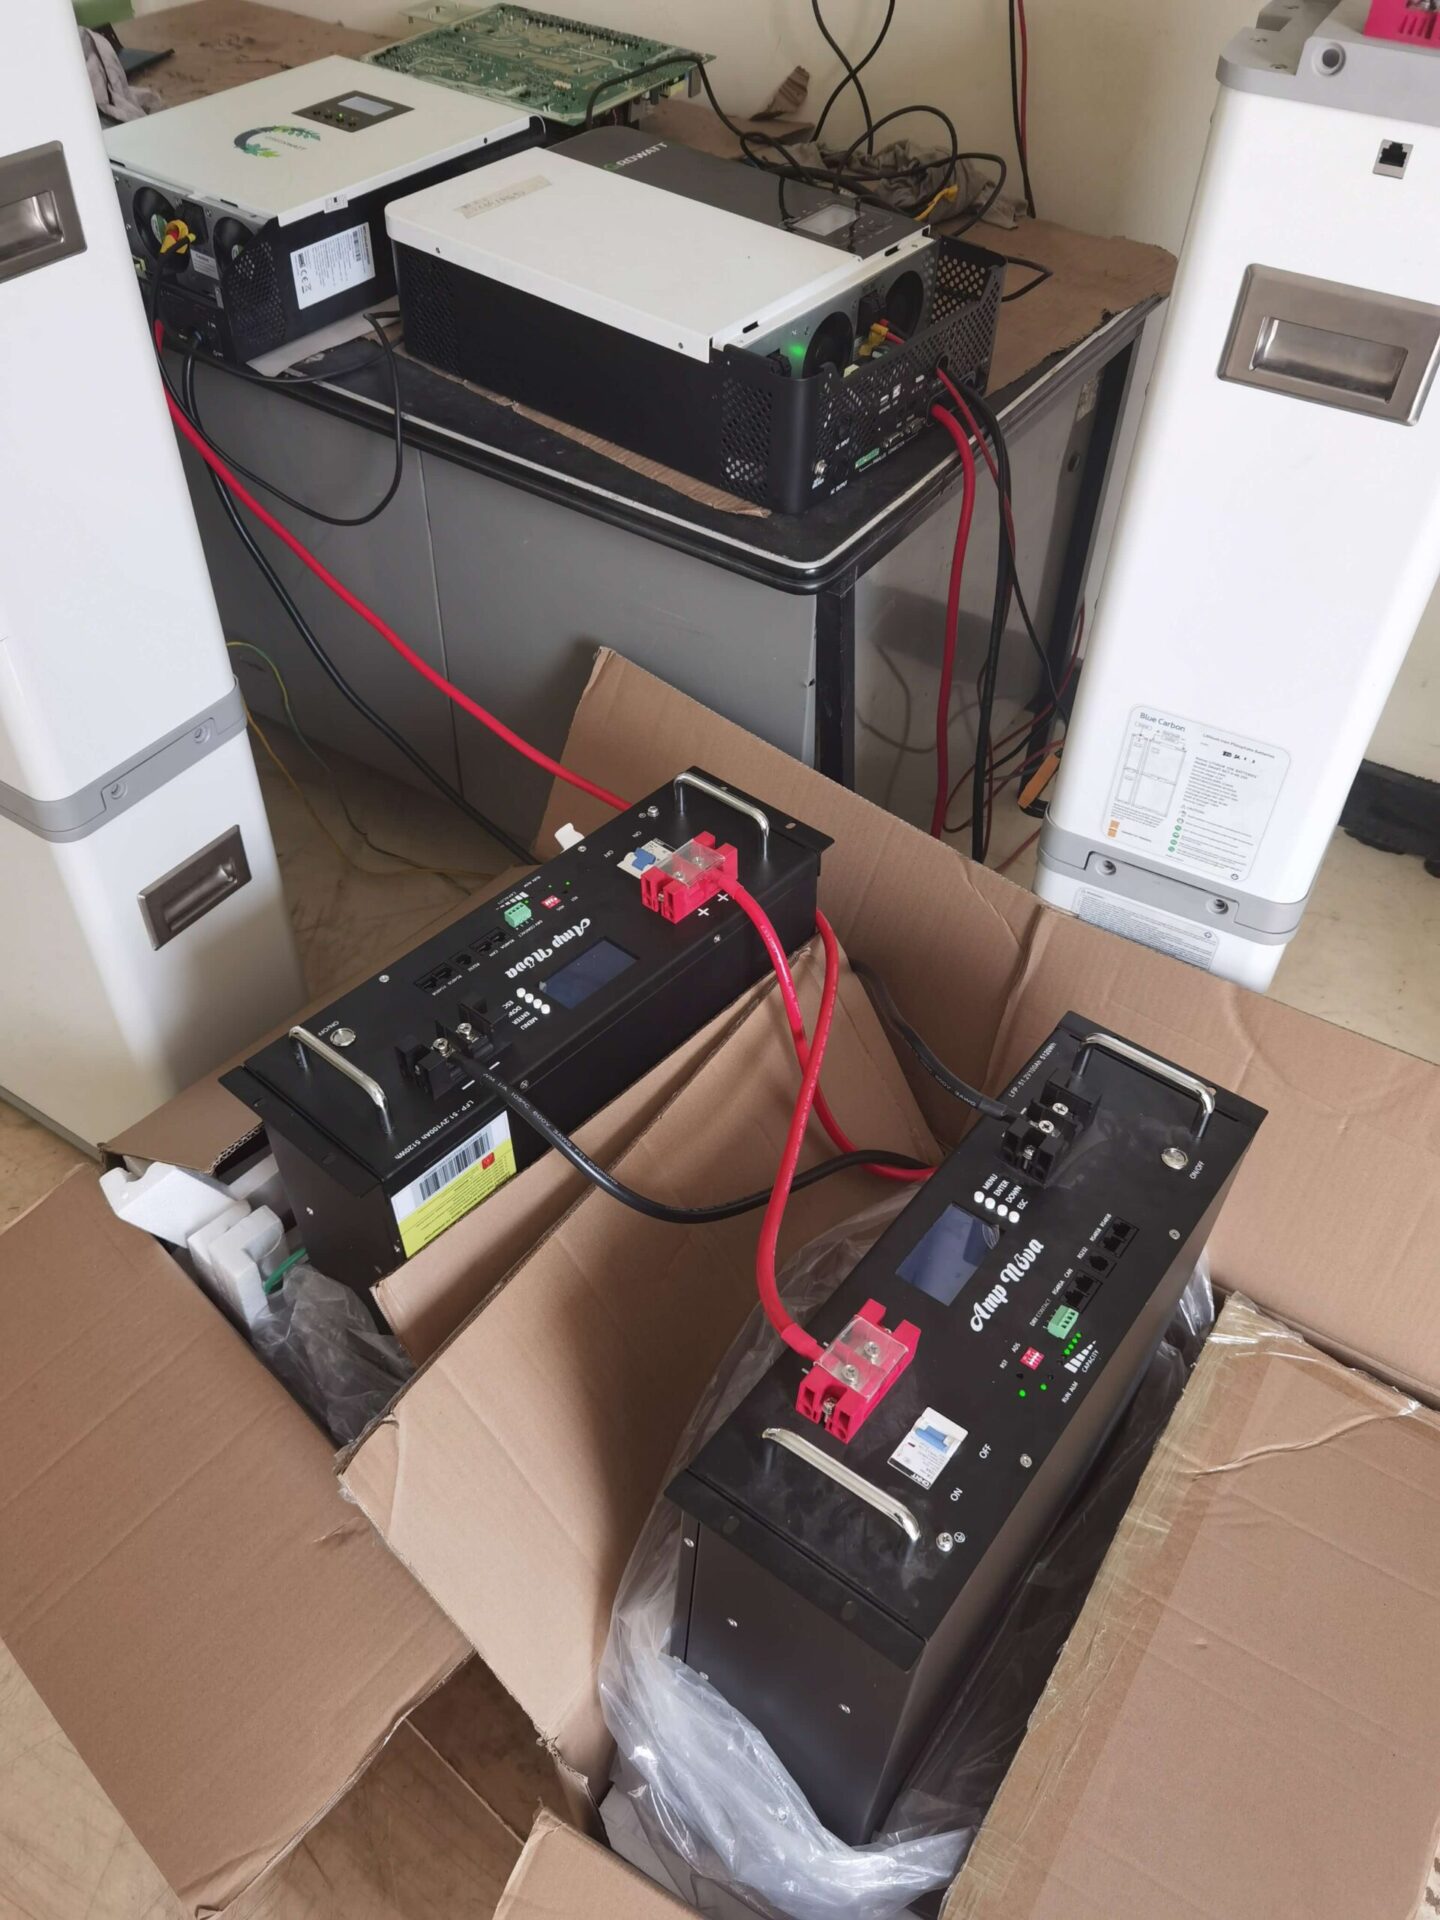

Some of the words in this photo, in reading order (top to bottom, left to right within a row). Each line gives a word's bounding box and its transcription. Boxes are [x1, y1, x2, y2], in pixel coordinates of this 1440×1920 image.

[1140, 712, 1157, 724] Blue
[1158, 718, 1186, 732] Carbon
[551, 918, 590, 947] Amp
[502, 1000, 514, 1009] ESC
[511, 1011, 530, 1024] ENTER
[520, 1016, 538, 1030] MENU
[1008, 1086, 1017, 1097] LFP
[461, 1100, 473, 1110] LFP
[1189, 1160, 1204, 1179] ON/OFF
[982, 1173, 997, 1189] MENU
[993, 1179, 1009, 1196] ENTER
[1004, 1185, 1021, 1203] DOWN
[1016, 1198, 1028, 1209] ESC
[1063, 1268, 1072, 1277] CAN
[970, 1284, 1008, 1331] Amp
[1029, 1316, 1038, 1326] DRY
[1035, 1298, 1050, 1317] CONTACT
[1081, 1349, 1098, 1372] CAPACITY
[1061, 1391, 1071, 1402] RUN
[1068, 1380, 1078, 1392] ALM
[978, 1443, 991, 1458] OFF
[950, 1487, 962, 1501] ON
